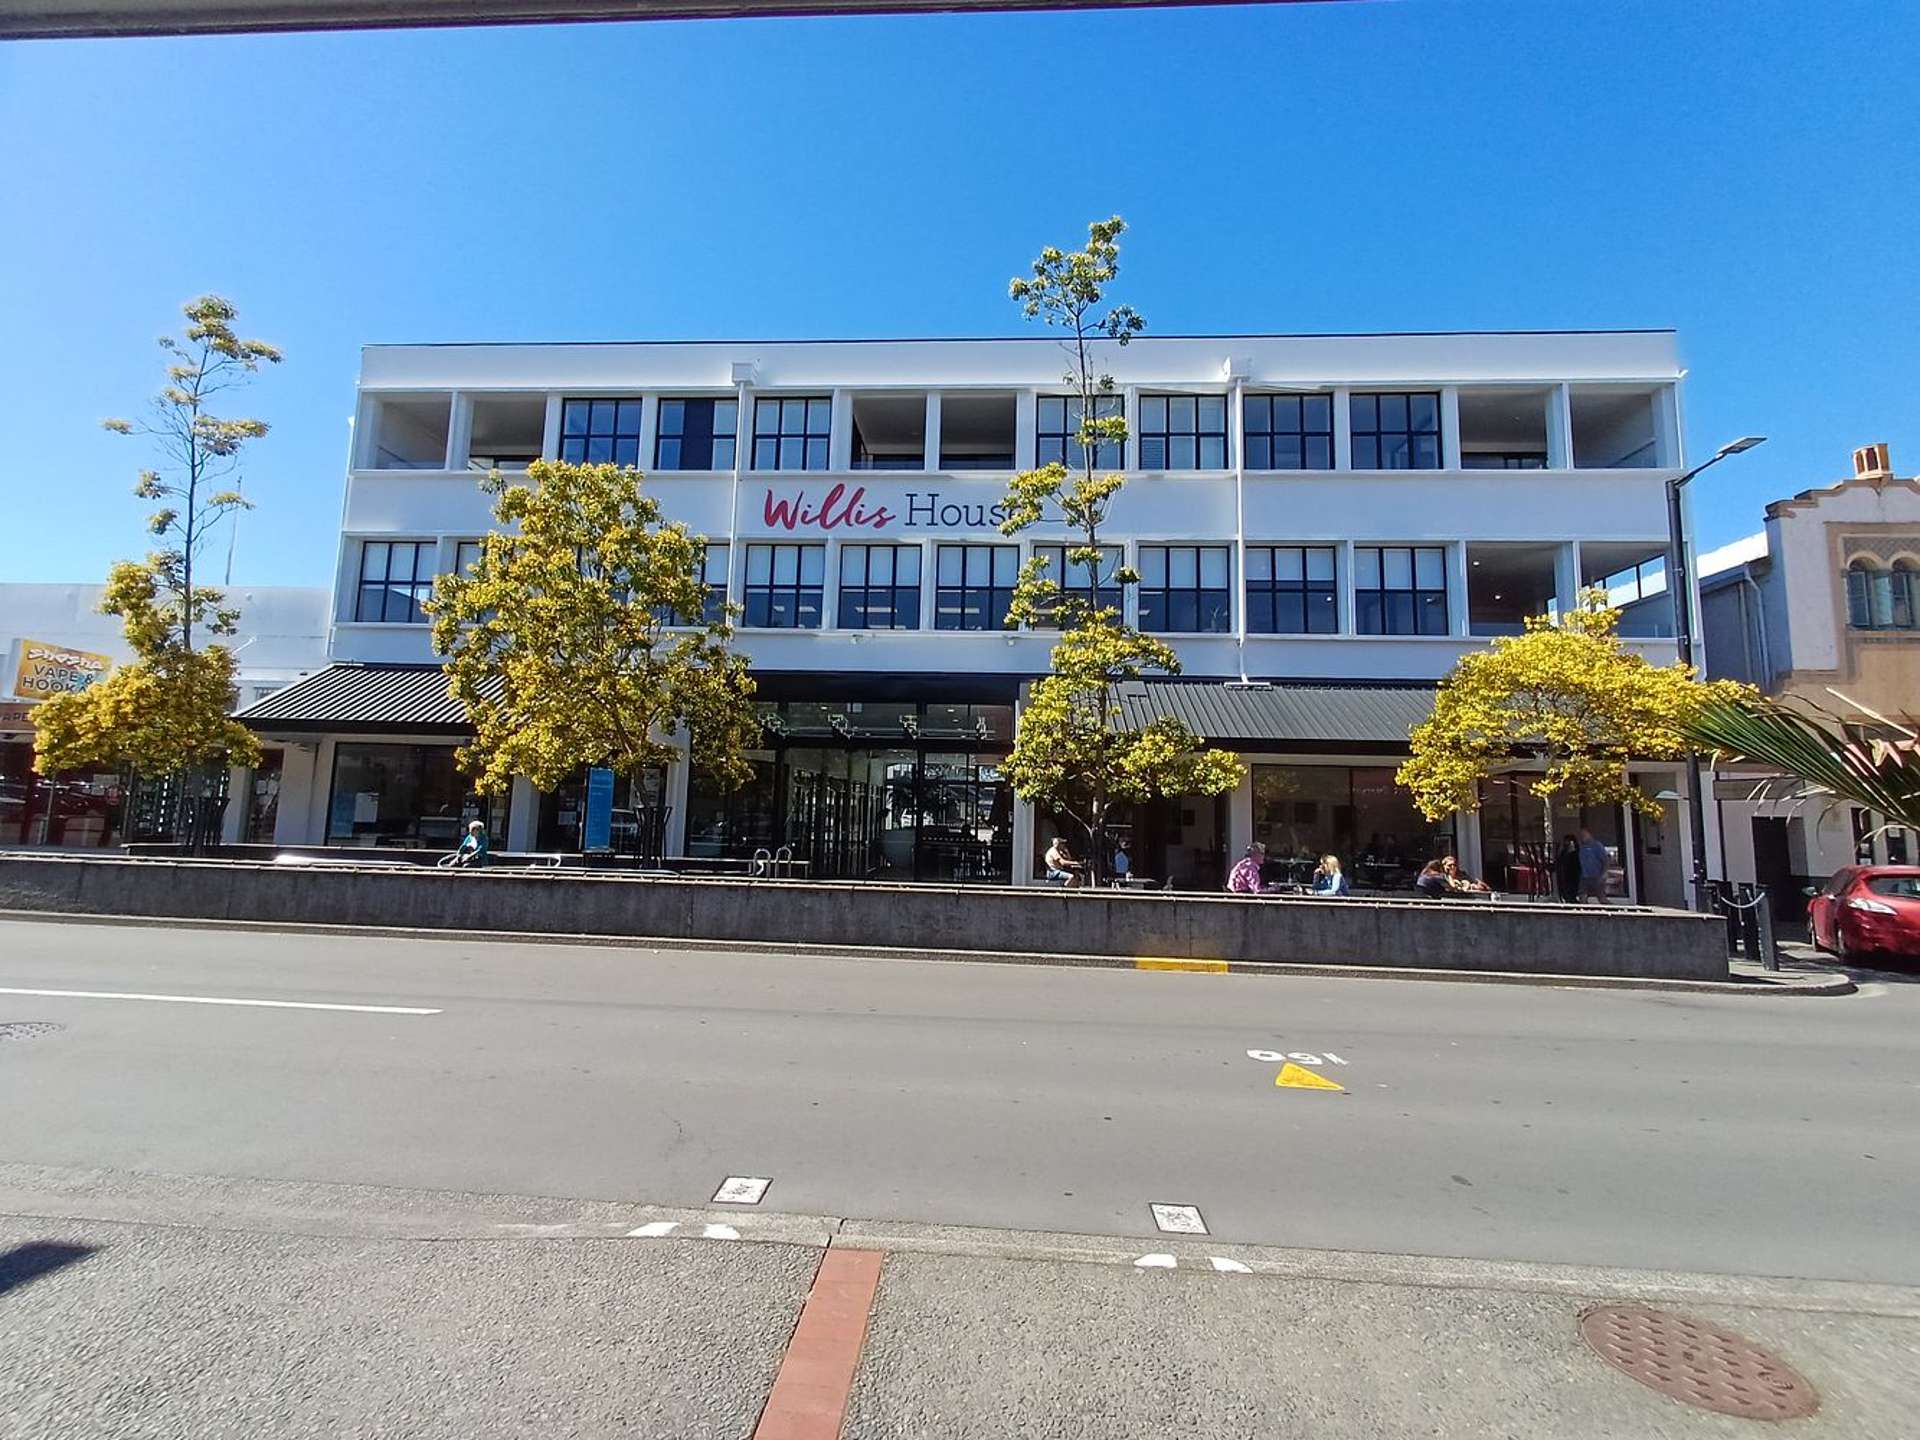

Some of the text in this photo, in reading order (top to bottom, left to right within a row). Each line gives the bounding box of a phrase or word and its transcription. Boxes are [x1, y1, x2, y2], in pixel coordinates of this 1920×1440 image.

[763, 483, 896, 531] Willis
[23, 676, 87, 693] HOOKA
[34, 664, 94, 685] VAPE &
